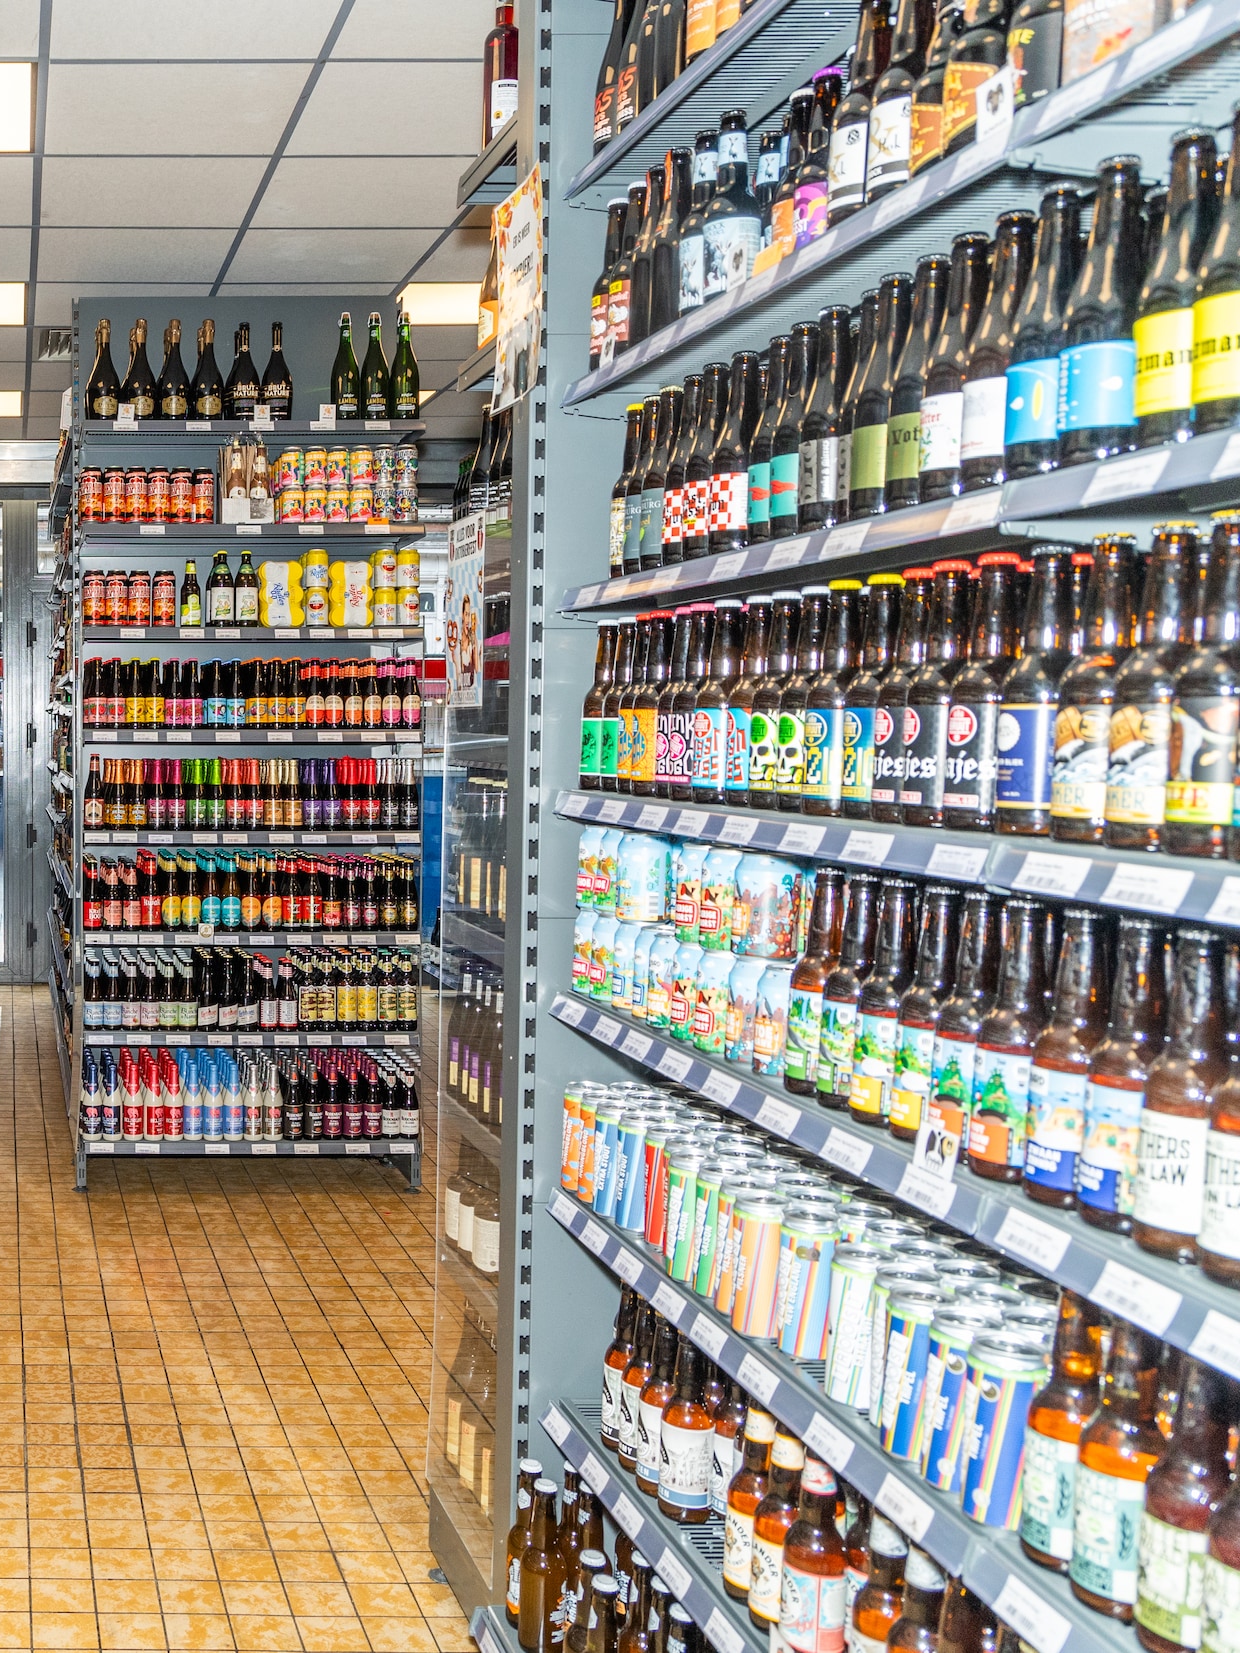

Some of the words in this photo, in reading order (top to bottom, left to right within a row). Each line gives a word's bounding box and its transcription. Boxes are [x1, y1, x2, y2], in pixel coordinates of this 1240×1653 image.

[602, 1146, 611, 1168] STOUT
[598, 1168, 607, 1190] EXTRA
[616, 1178, 624, 1201] EXTRA
[620, 1155, 628, 1178] STOUT
[678, 1211, 690, 1241] SAISON
[701, 1225, 713, 1256] SAISON
[722, 1238, 733, 1273] PILSNER
[736, 1255, 748, 1291] PILSNER
[787, 1262, 802, 1307] ENGLAND
